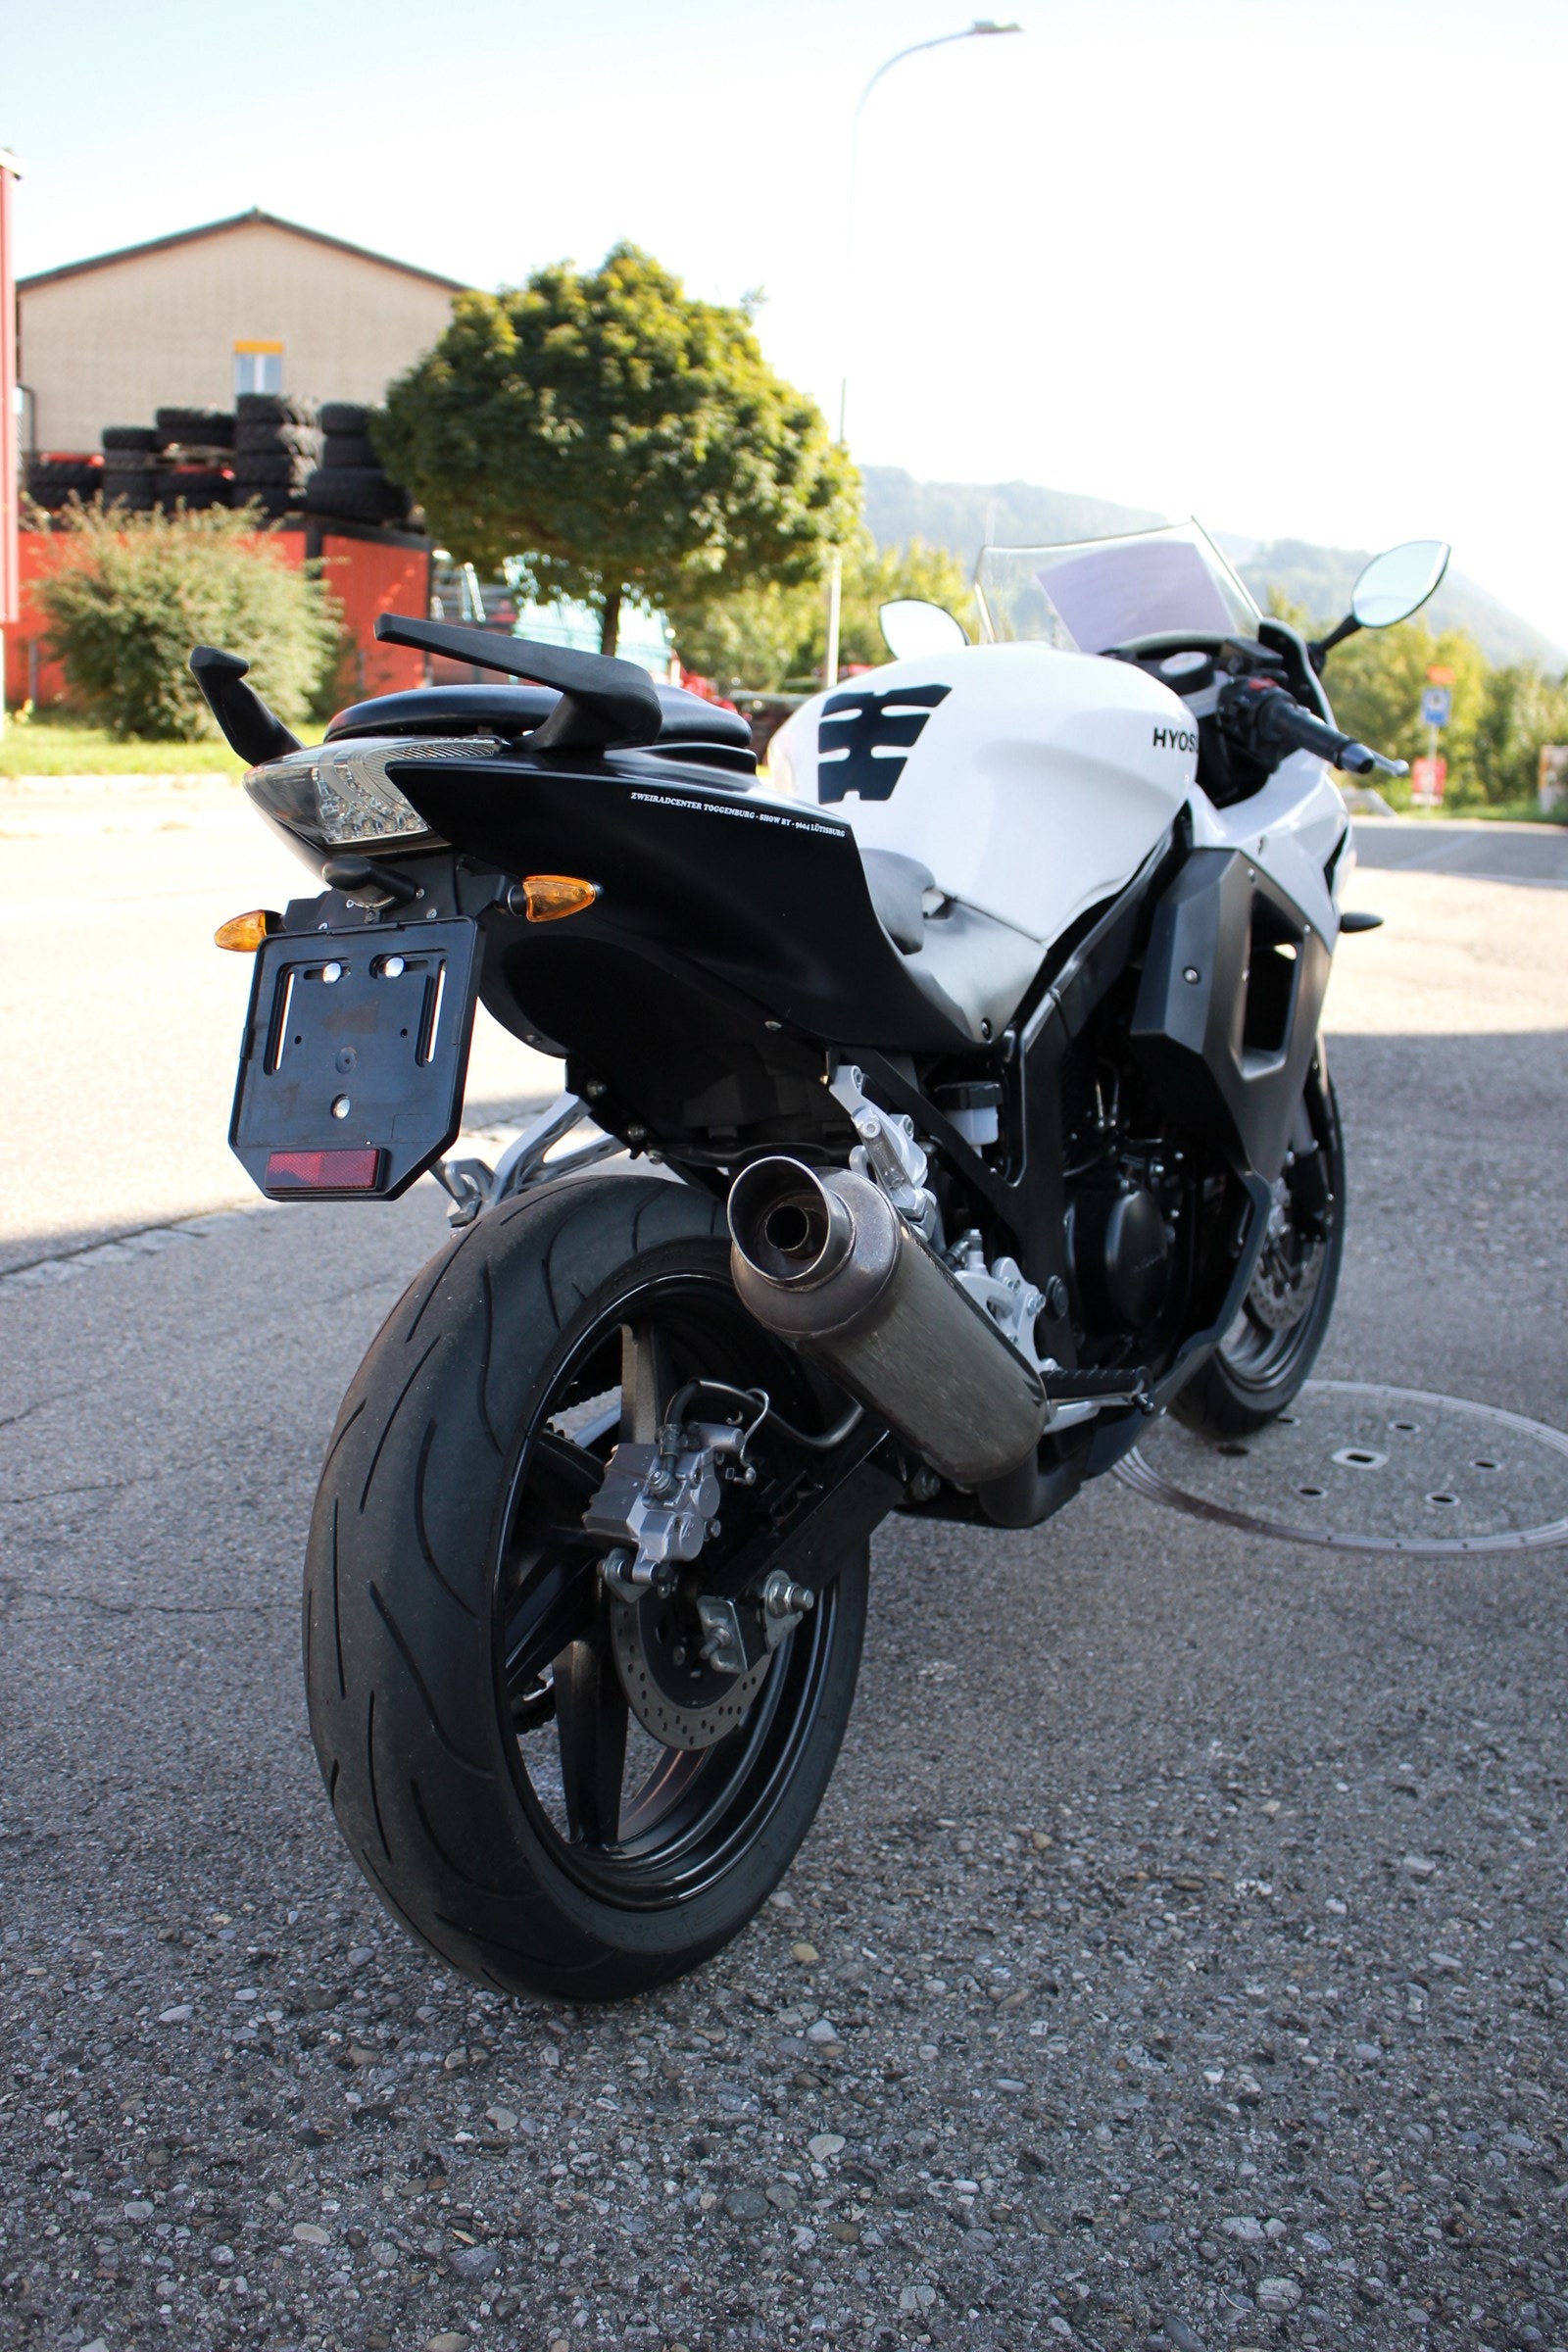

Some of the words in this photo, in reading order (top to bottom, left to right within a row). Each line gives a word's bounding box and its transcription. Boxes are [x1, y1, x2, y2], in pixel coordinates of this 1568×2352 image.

[1153, 727, 1198, 753] HYOS
[630, 792, 702, 809] ZWEIRADCENTER
[704, 804, 755, 818] TOGGENBURG
[759, 813, 780, 824] SHOW
